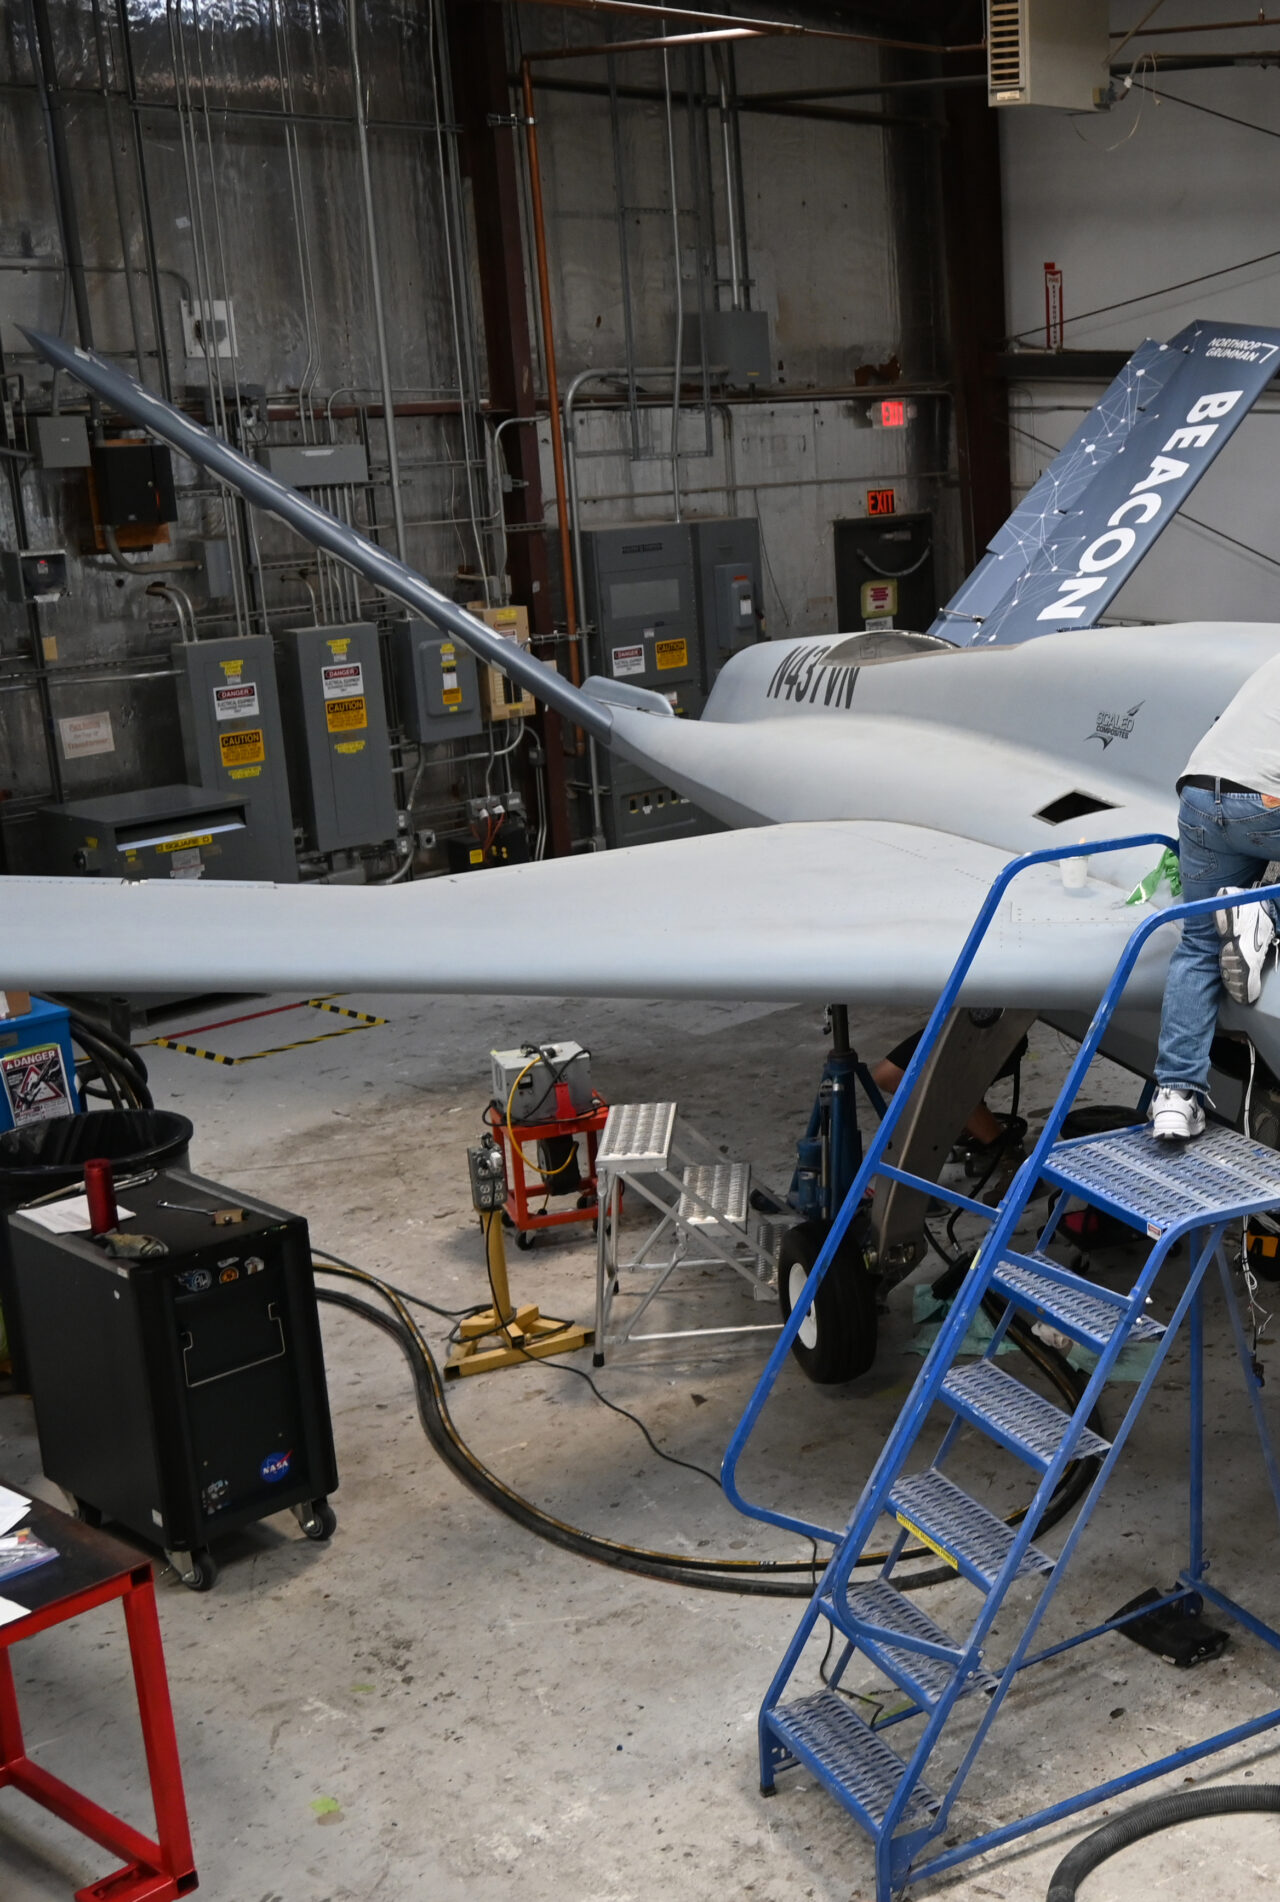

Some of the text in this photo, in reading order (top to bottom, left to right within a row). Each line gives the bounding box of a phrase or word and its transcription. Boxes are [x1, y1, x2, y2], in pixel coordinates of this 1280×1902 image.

[1208, 338, 1262, 350] NORTHROP
[1205, 347, 1259, 361] GRUMMAN
[882, 401, 904, 426] EXIT
[869, 491, 894, 514] EXIT
[1036, 390, 1244, 621] BEACON
[328, 668, 355, 678] DANGER
[221, 689, 250, 699] DANGER
[328, 699, 363, 714] CAUTION
[222, 734, 260, 747] CAUTION
[14, 1050, 56, 1069] DANGER
[263, 1460, 289, 1475] NASA
